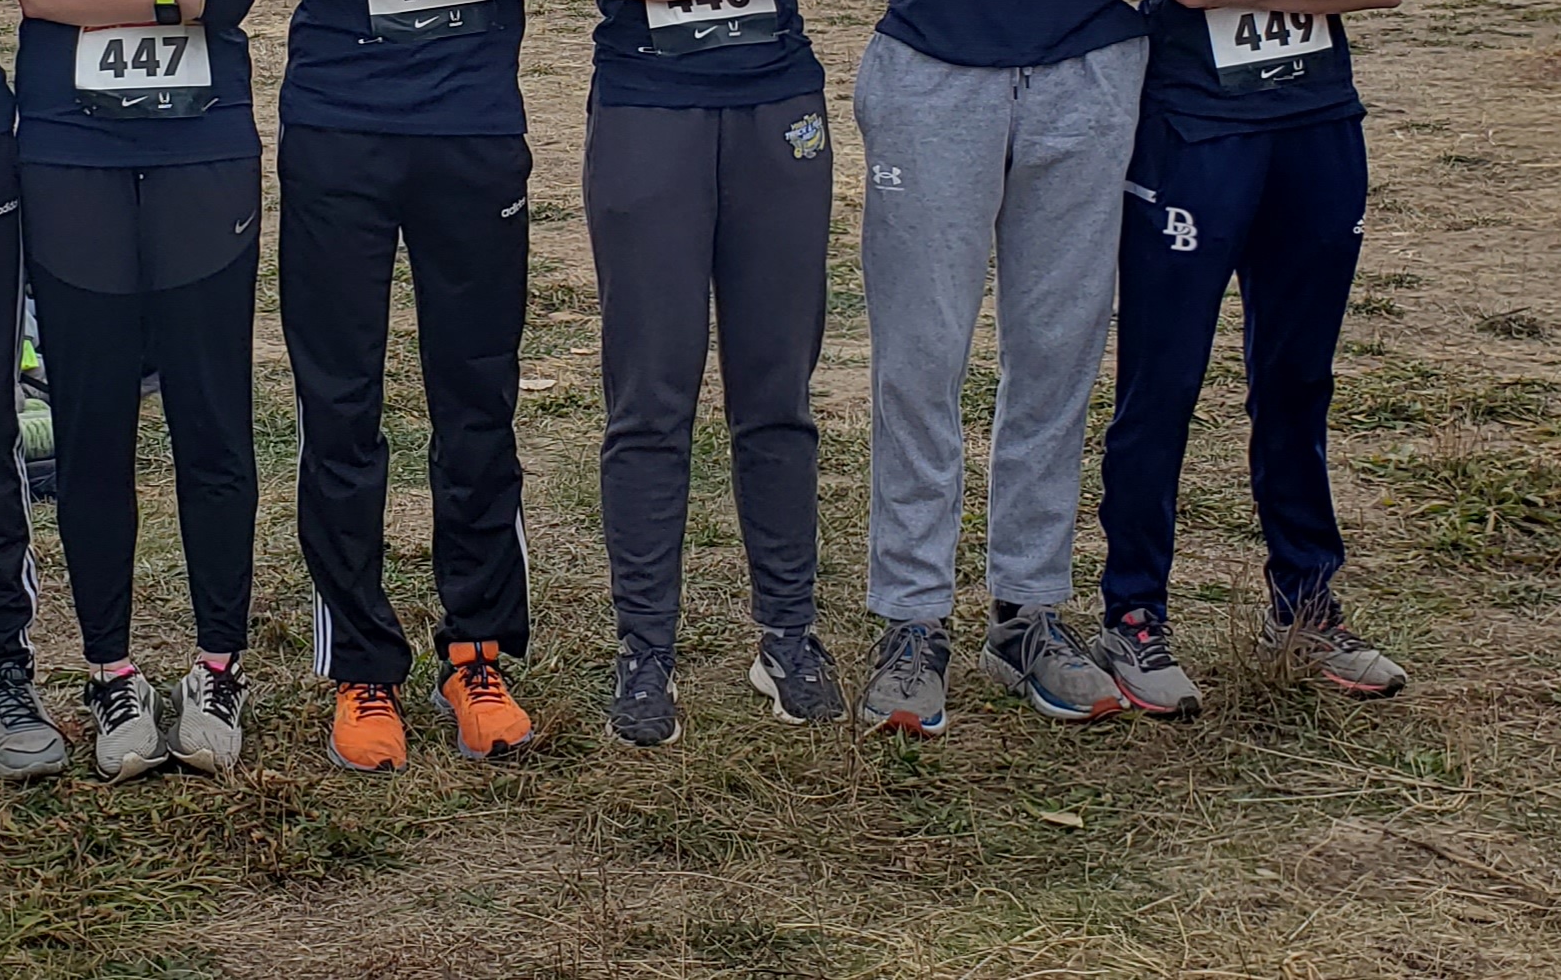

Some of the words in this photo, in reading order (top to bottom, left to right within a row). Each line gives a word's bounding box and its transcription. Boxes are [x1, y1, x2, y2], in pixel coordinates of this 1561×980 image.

[1234, 10, 1314, 52] 449
[99, 36, 189, 78] 447
[1163, 206, 1198, 251] DB
